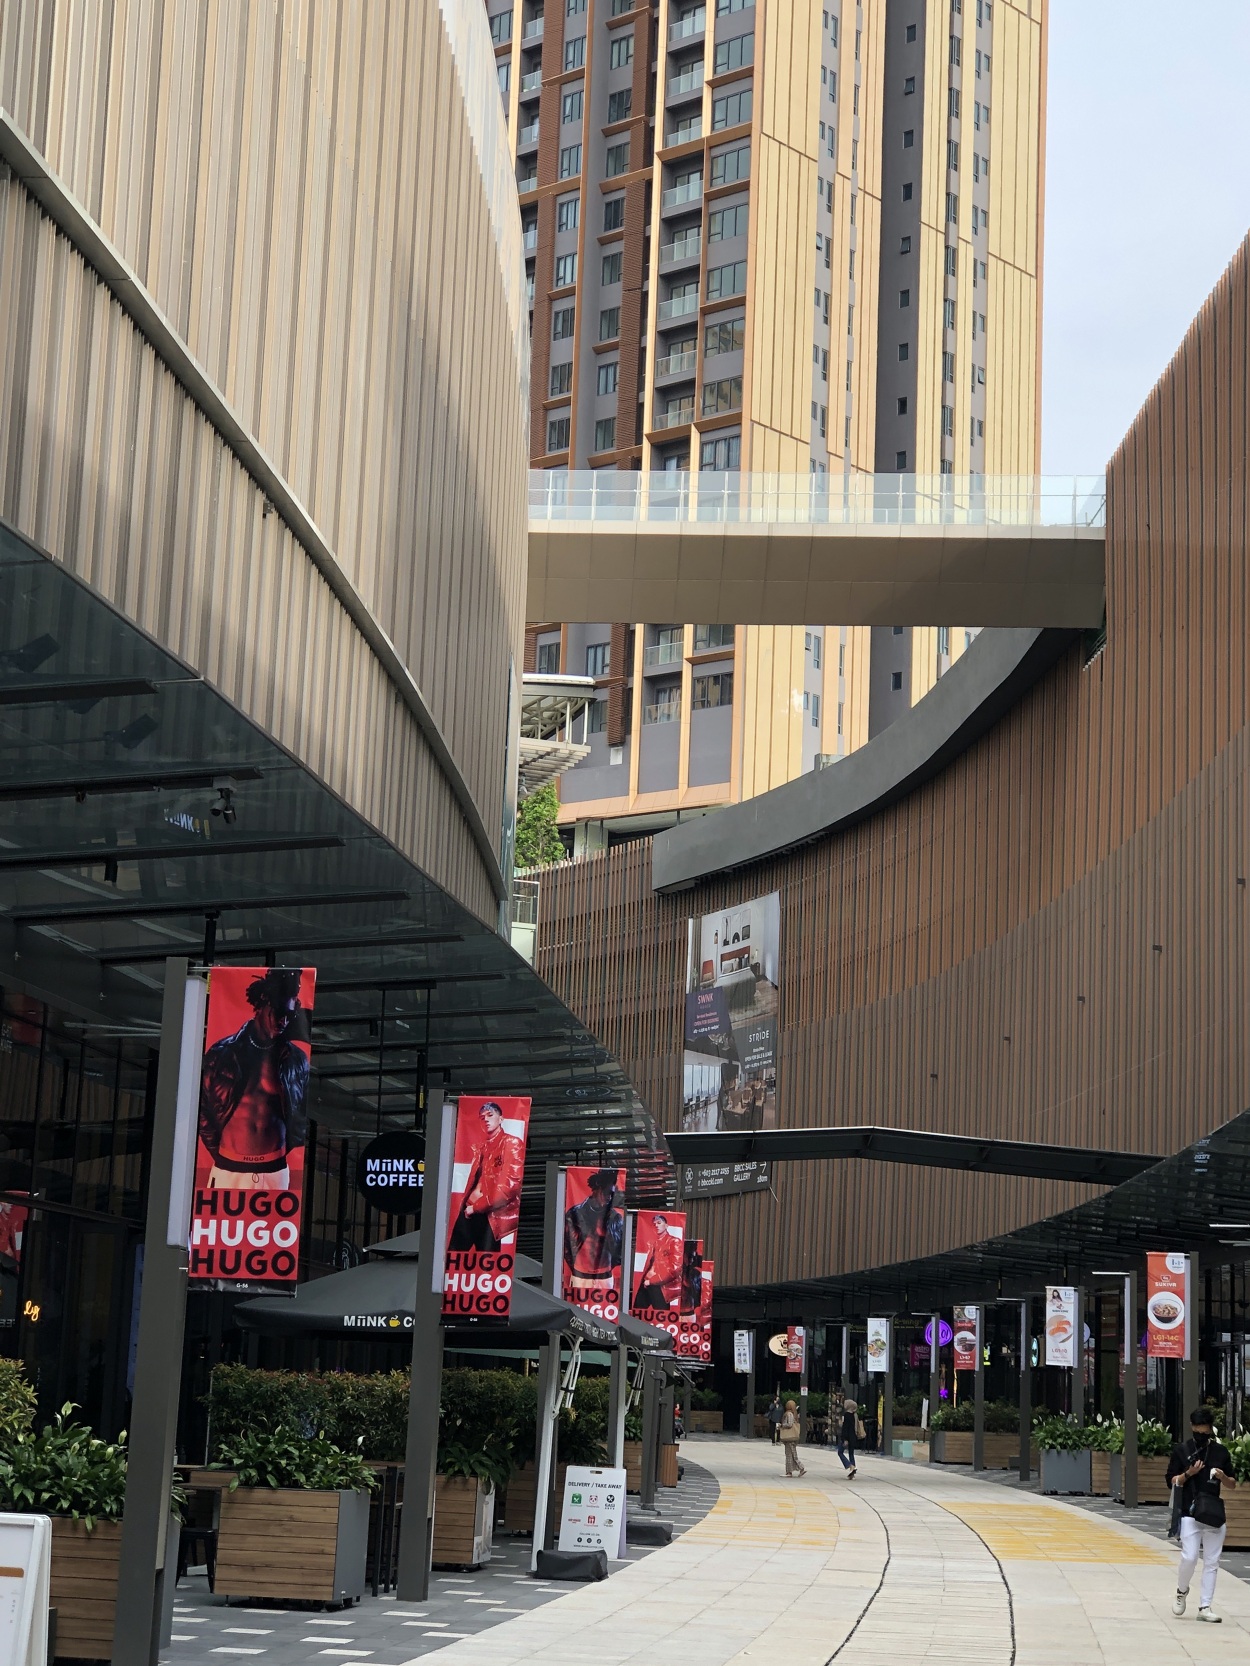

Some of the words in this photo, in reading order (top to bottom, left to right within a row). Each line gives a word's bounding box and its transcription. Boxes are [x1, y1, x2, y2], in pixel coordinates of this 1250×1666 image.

[749, 1030, 769, 1042] STRIDE
[733, 1172, 751, 1182] GALLERY
[195, 1190, 300, 1218] HUGO
[192, 1219, 298, 1248] HUGO
[190, 1249, 296, 1277] HUGO
[445, 1252, 514, 1272] HUGO
[443, 1273, 512, 1293] HUGO
[442, 1294, 509, 1314] HUGO
[563, 1288, 619, 1304] HUGO
[632, 1310, 679, 1323] HUGO
